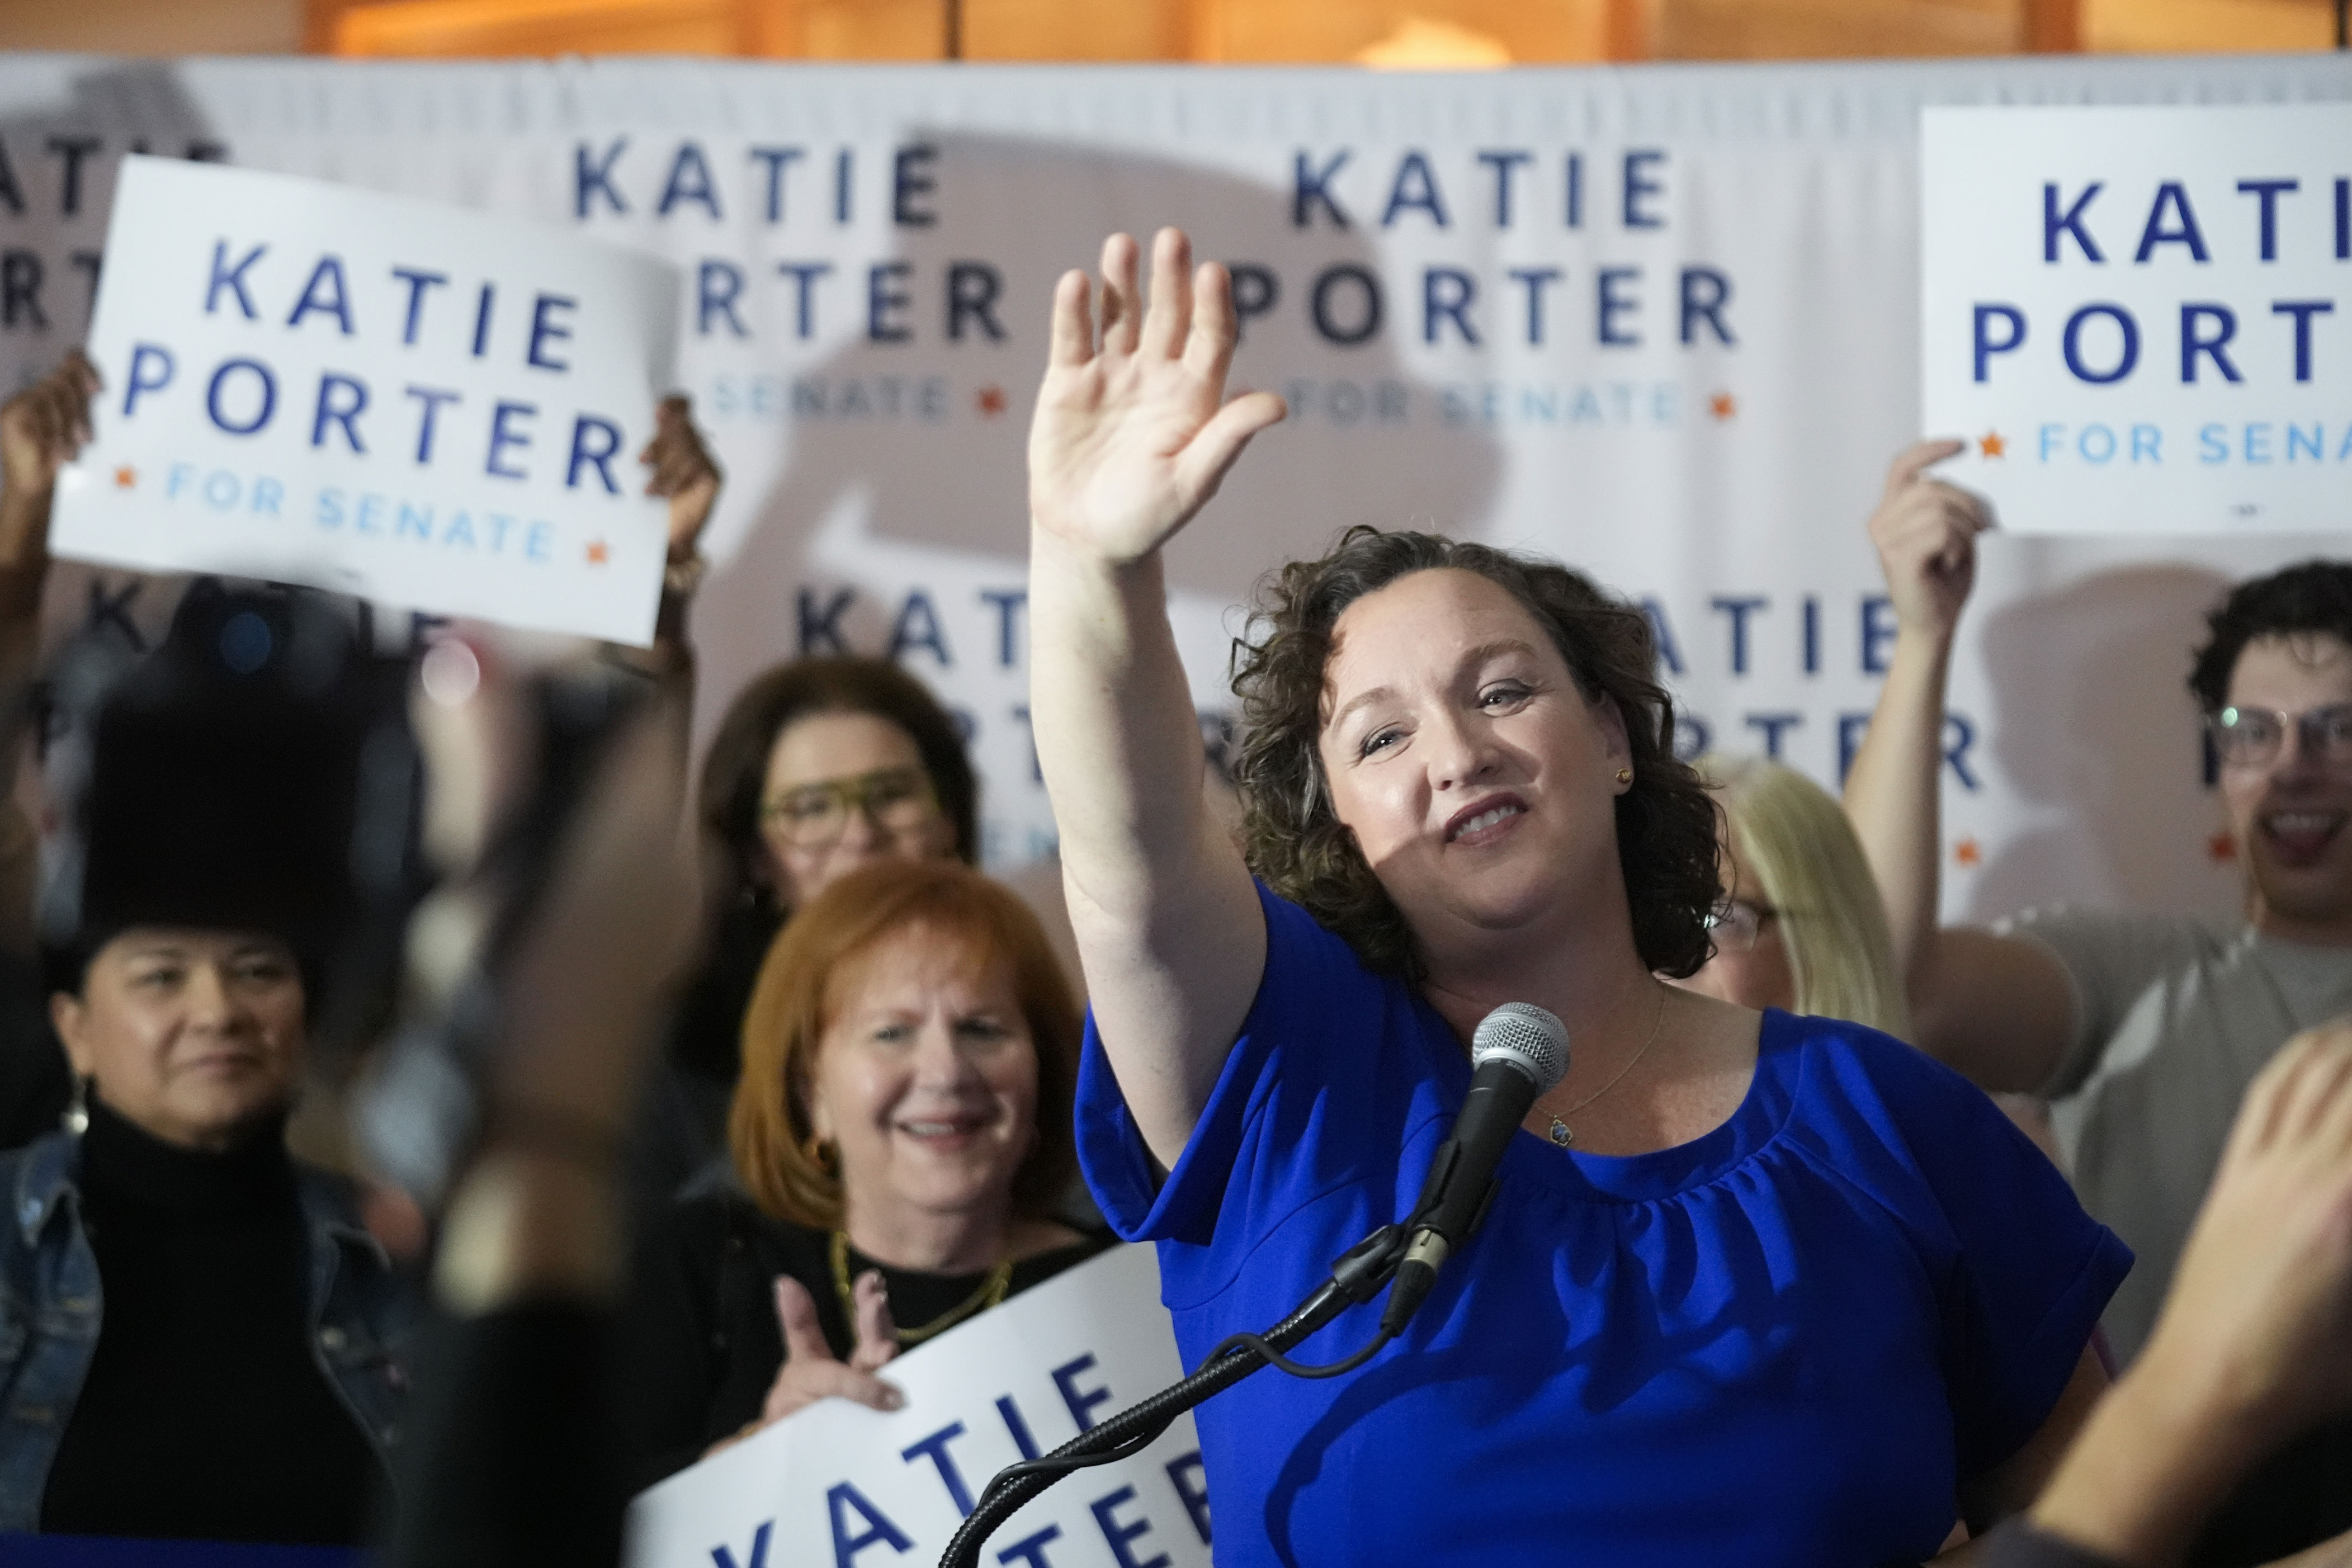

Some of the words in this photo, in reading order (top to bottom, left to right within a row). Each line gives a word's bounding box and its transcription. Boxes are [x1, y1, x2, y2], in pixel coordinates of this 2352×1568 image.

[575, 136, 939, 227] KATIE
[1292, 149, 1668, 228] KATIE
[205, 239, 578, 371] KATIE
[696, 259, 1009, 342] RTER
[1230, 261, 1738, 348] PORTER
[124, 343, 625, 495] PORTER
[714, 376, 948, 421] SENATE
[1442, 381, 1679, 427] SENATE
[2038, 422, 2164, 464] FOR
[168, 463, 284, 516] FOR
[317, 488, 555, 561] SENATE
[796, 584, 1029, 669] KAT
